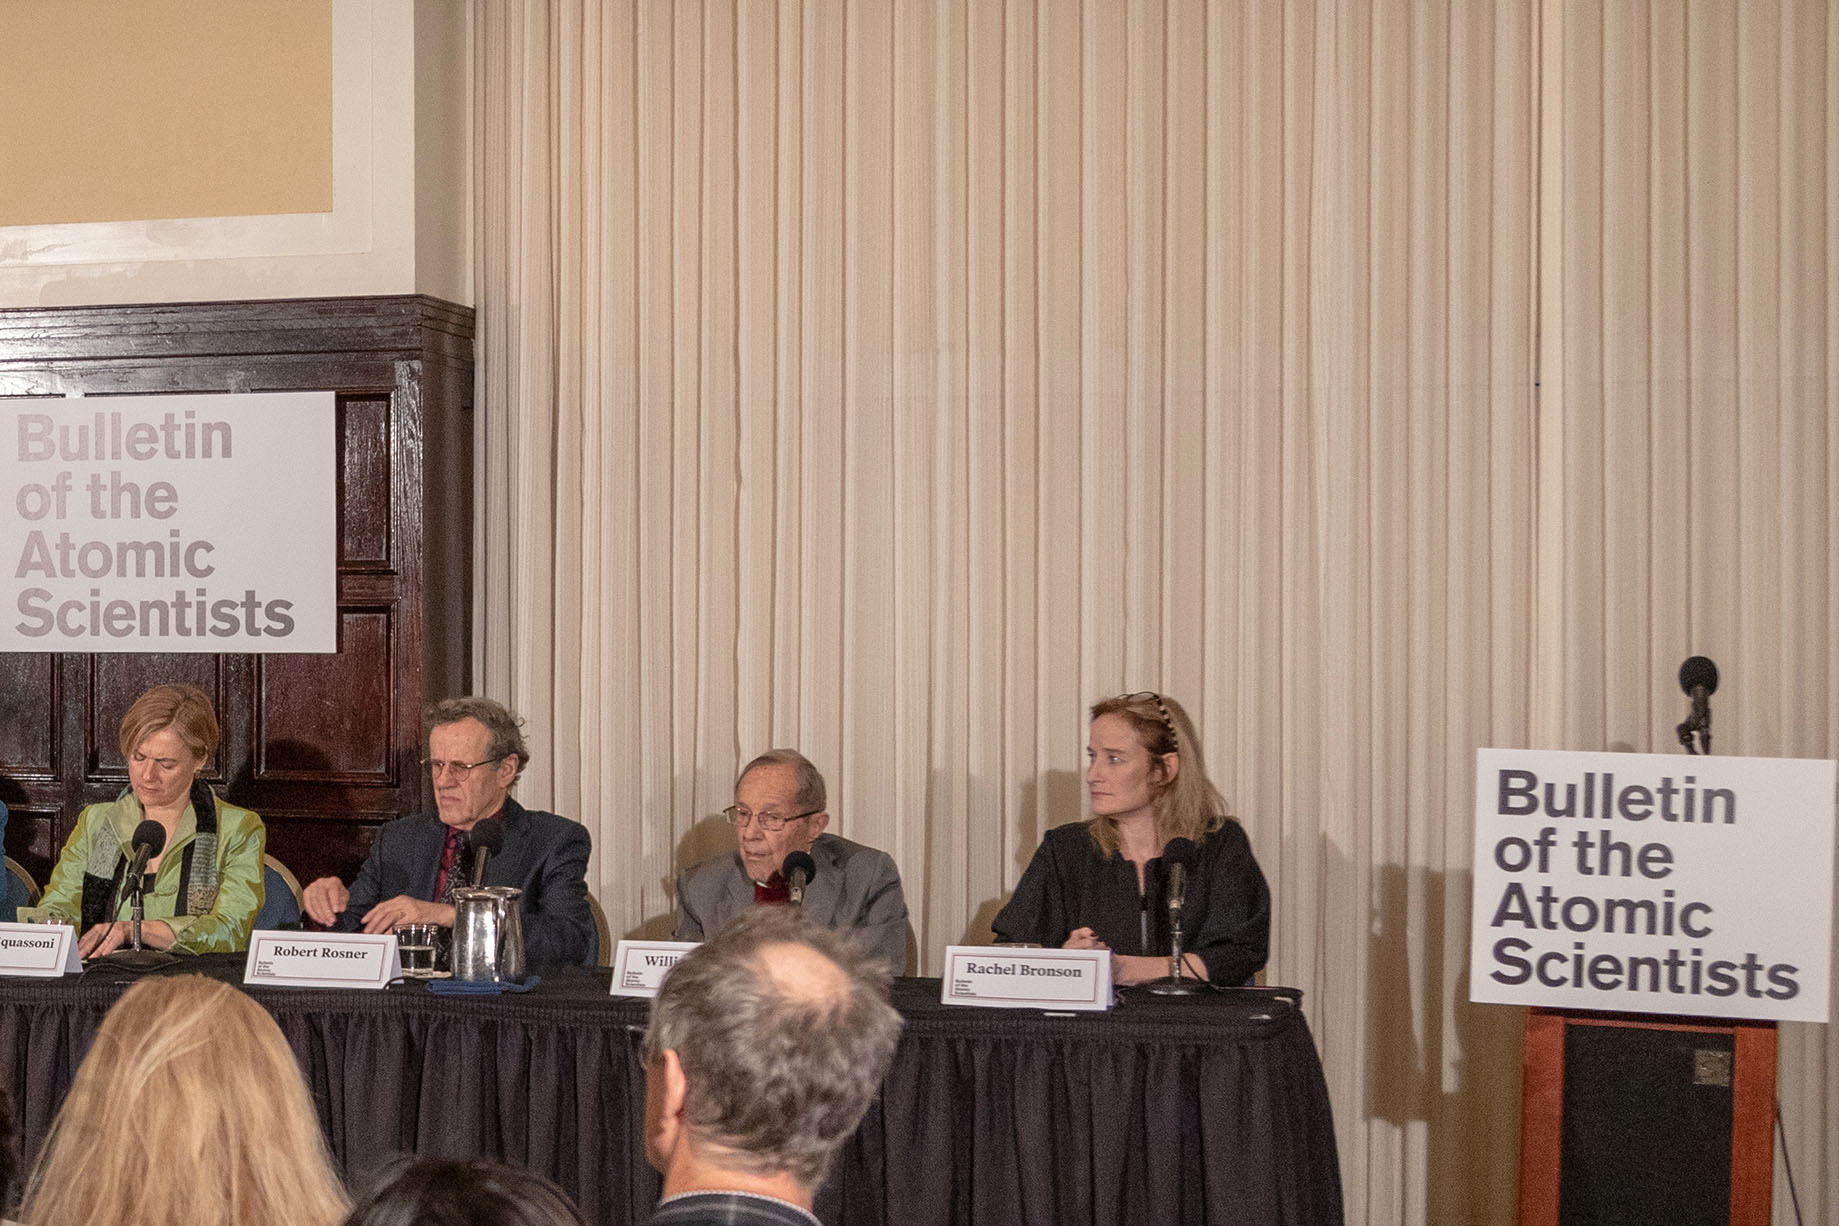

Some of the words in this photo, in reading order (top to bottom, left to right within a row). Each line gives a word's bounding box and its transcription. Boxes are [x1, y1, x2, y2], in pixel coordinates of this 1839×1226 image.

[17, 410, 232, 462] Bulletin
[16, 471, 72, 521] of
[86, 471, 178, 520] the
[14, 529, 215, 579] Atomic
[14, 588, 295, 638] Scientists
[1497, 769, 1737, 825] Bulletin
[1494, 827, 1557, 874] of
[1572, 829, 1674, 879] the
[1490, 882, 1714, 938] Atomic
[273, 946, 318, 957] Robert
[321, 947, 368, 959] Rosner
[966, 962, 1016, 975] Rachel
[1020, 965, 1082, 977] Bronson
[1490, 937, 1801, 1001] Scientists
